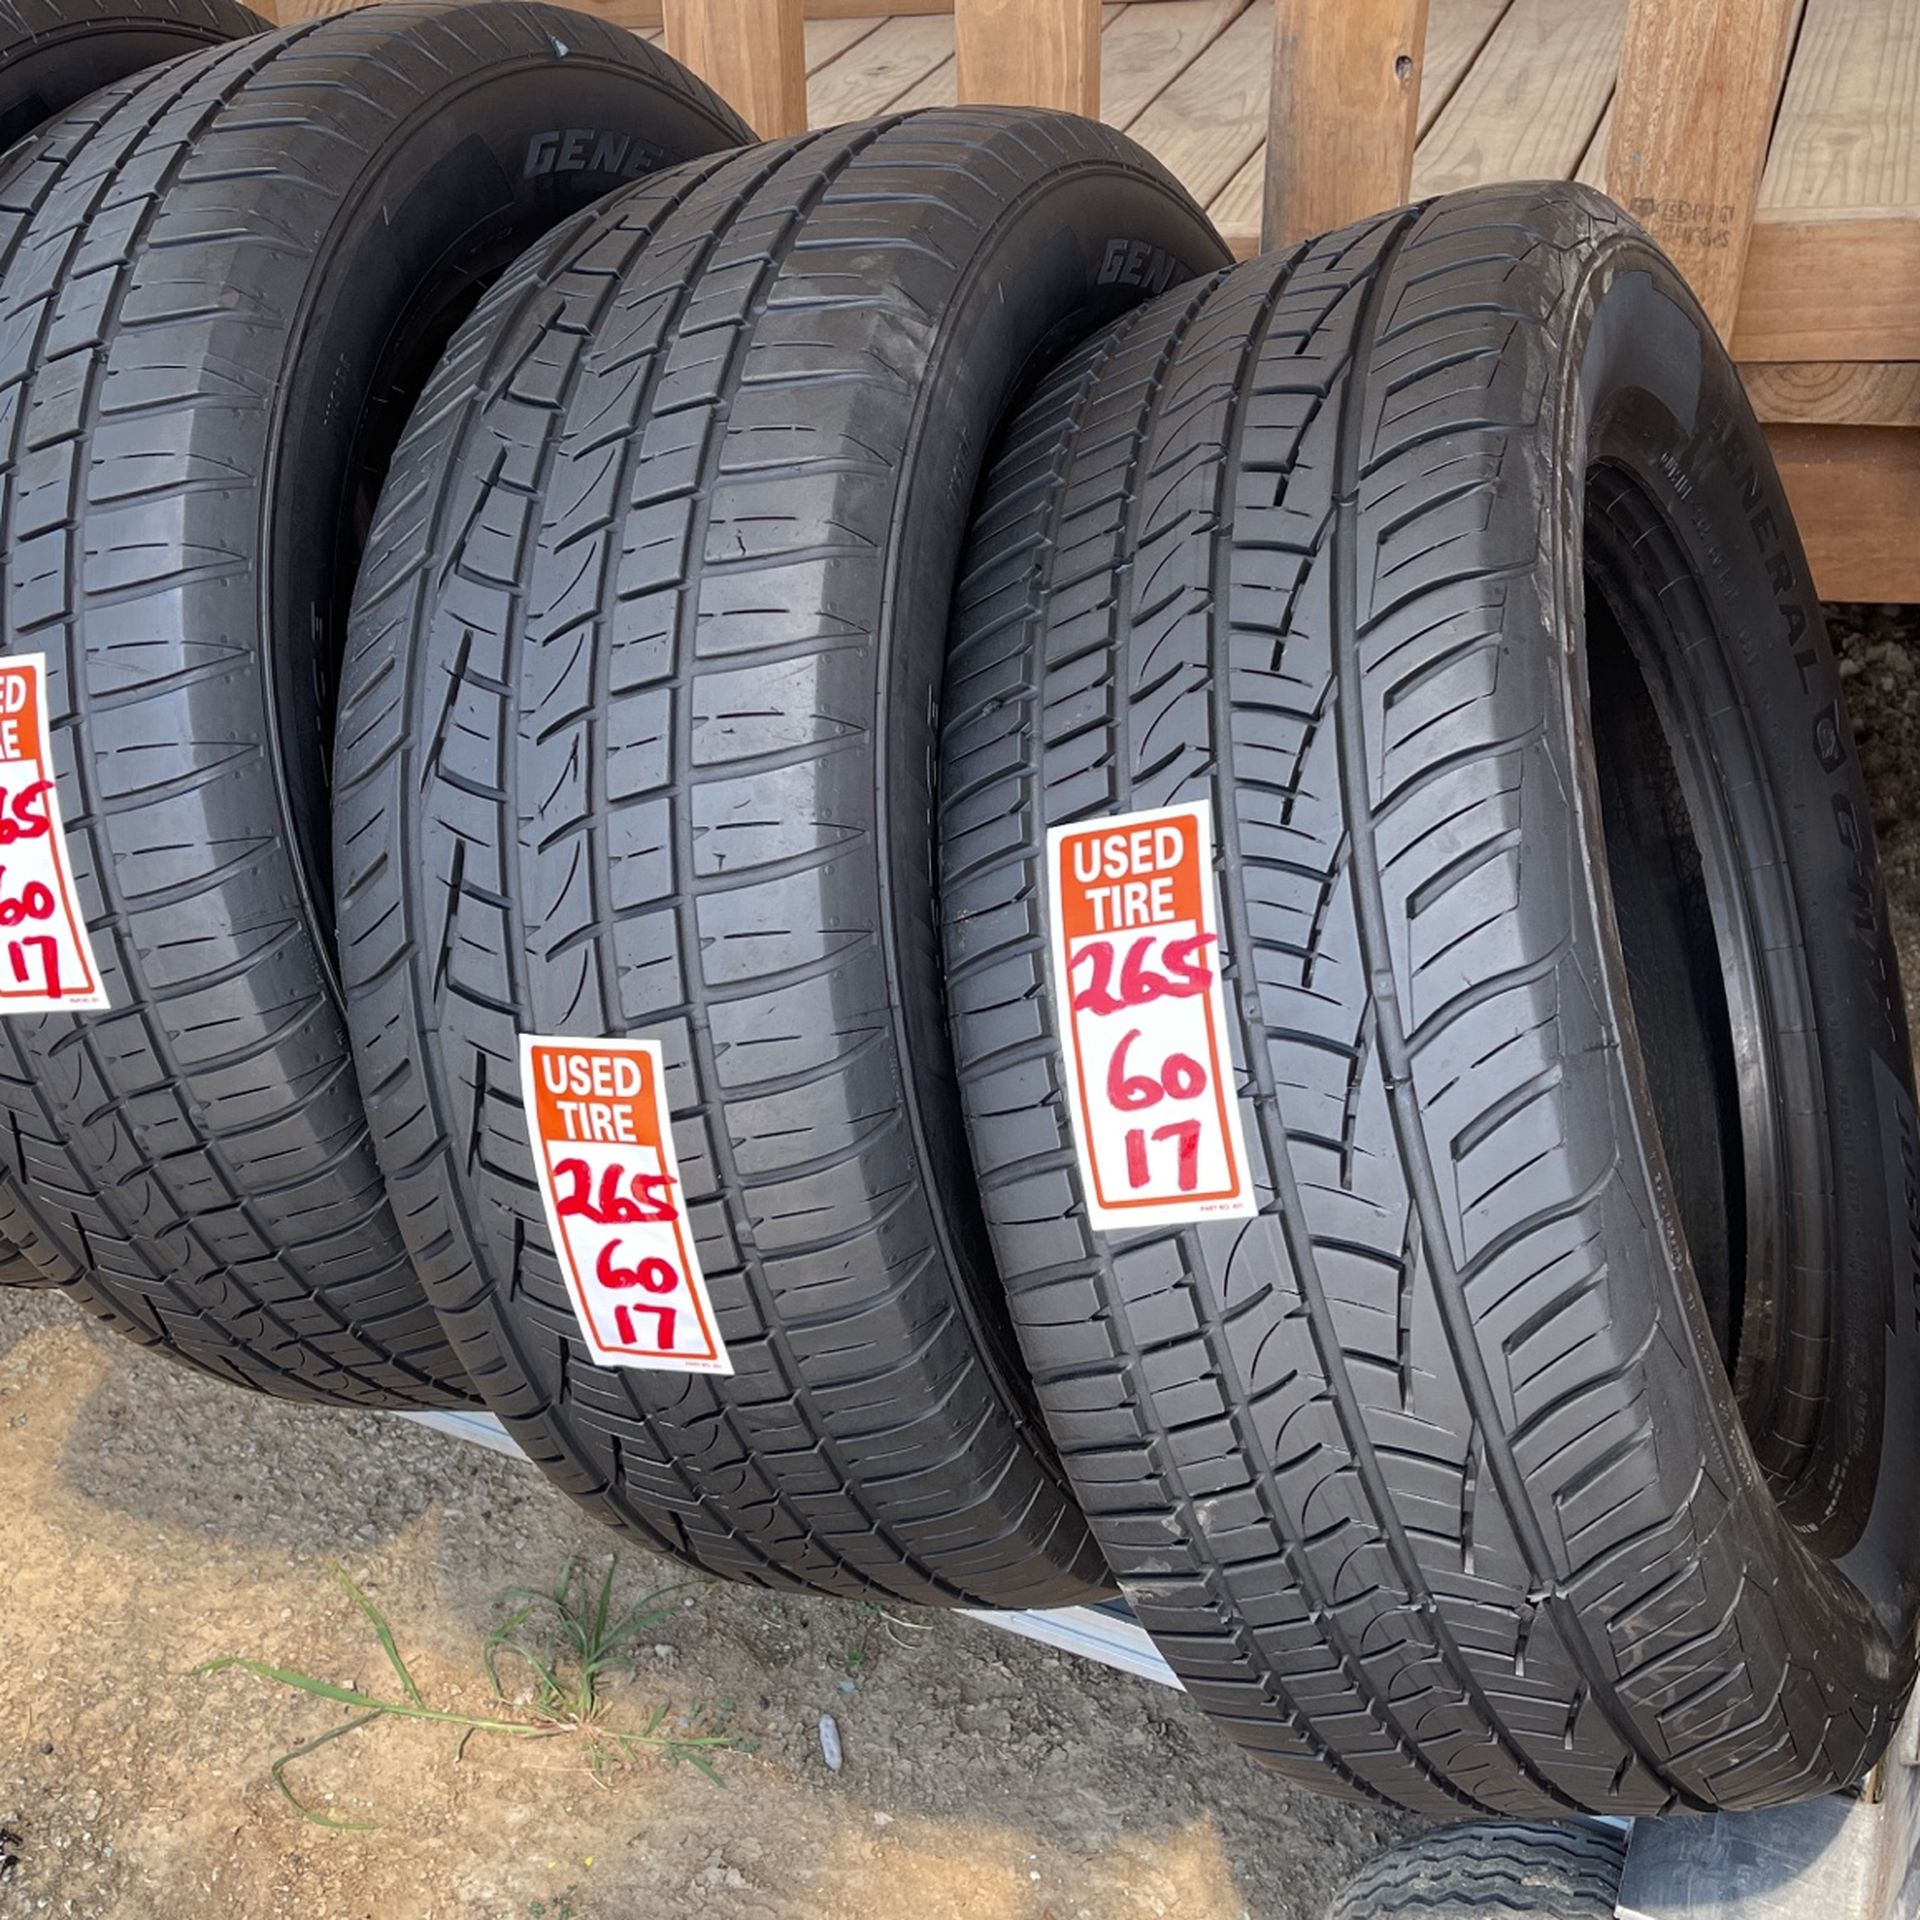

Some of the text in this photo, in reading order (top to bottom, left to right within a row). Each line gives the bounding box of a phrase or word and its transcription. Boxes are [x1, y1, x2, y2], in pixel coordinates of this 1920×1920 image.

[524, 128, 664, 178] GENE
[1097, 238, 1177, 294] GEN
[0, 780, 54, 845] 65
[1073, 826, 1184, 883] USED
[1085, 877, 1175, 931] TIRE
[8, 936, 62, 998] 17
[1067, 933, 1217, 1016] 265
[541, 1053, 642, 1098] USED
[1107, 1029, 1206, 1112] 60
[556, 1101, 637, 1143] TIRE
[1124, 1118, 1201, 1191] 17
[552, 1158, 679, 1225] 265
[596, 1238, 678, 1294] 60
[613, 1304, 676, 1350] 17
